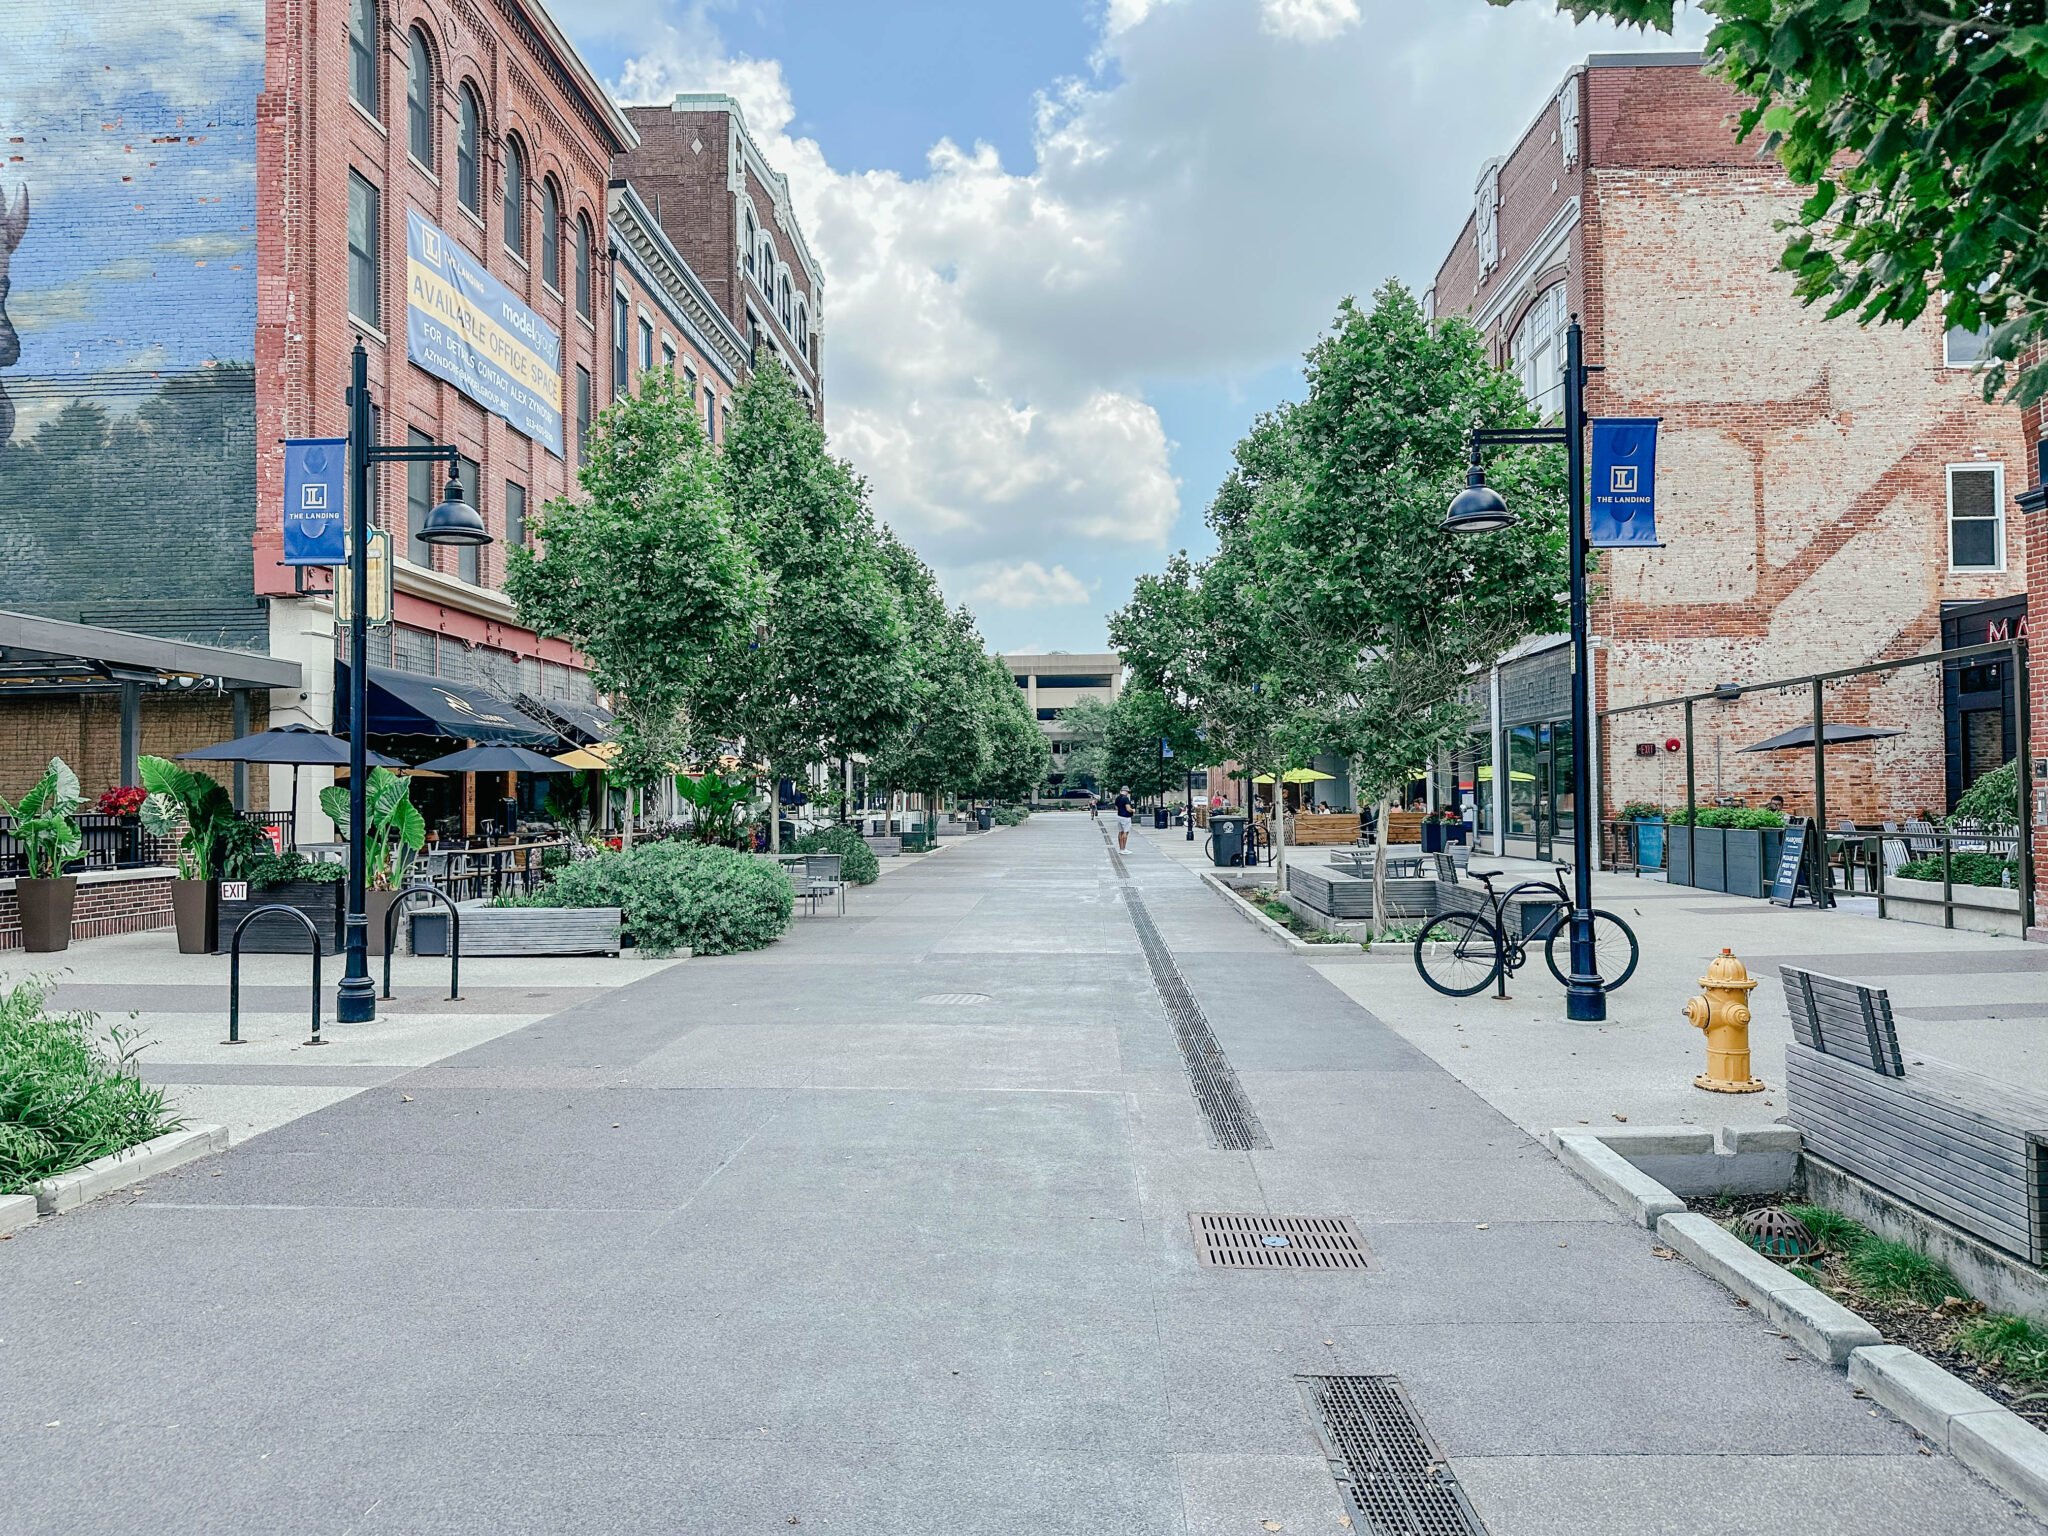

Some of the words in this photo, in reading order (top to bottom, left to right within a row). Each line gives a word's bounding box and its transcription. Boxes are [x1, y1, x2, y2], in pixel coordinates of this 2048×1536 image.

[413, 275, 486, 345] AVAILABLE
[489, 331, 527, 377] OFFICE
[531, 363, 558, 402] SPACE
[423, 322, 442, 346] FOR
[477, 361, 508, 393] CONTACT
[510, 385, 527, 406] ALEX
[305, 512, 340, 520] LANDING
[1640, 744, 1653, 755] EXIT
[223, 884, 246, 898] EXIT
